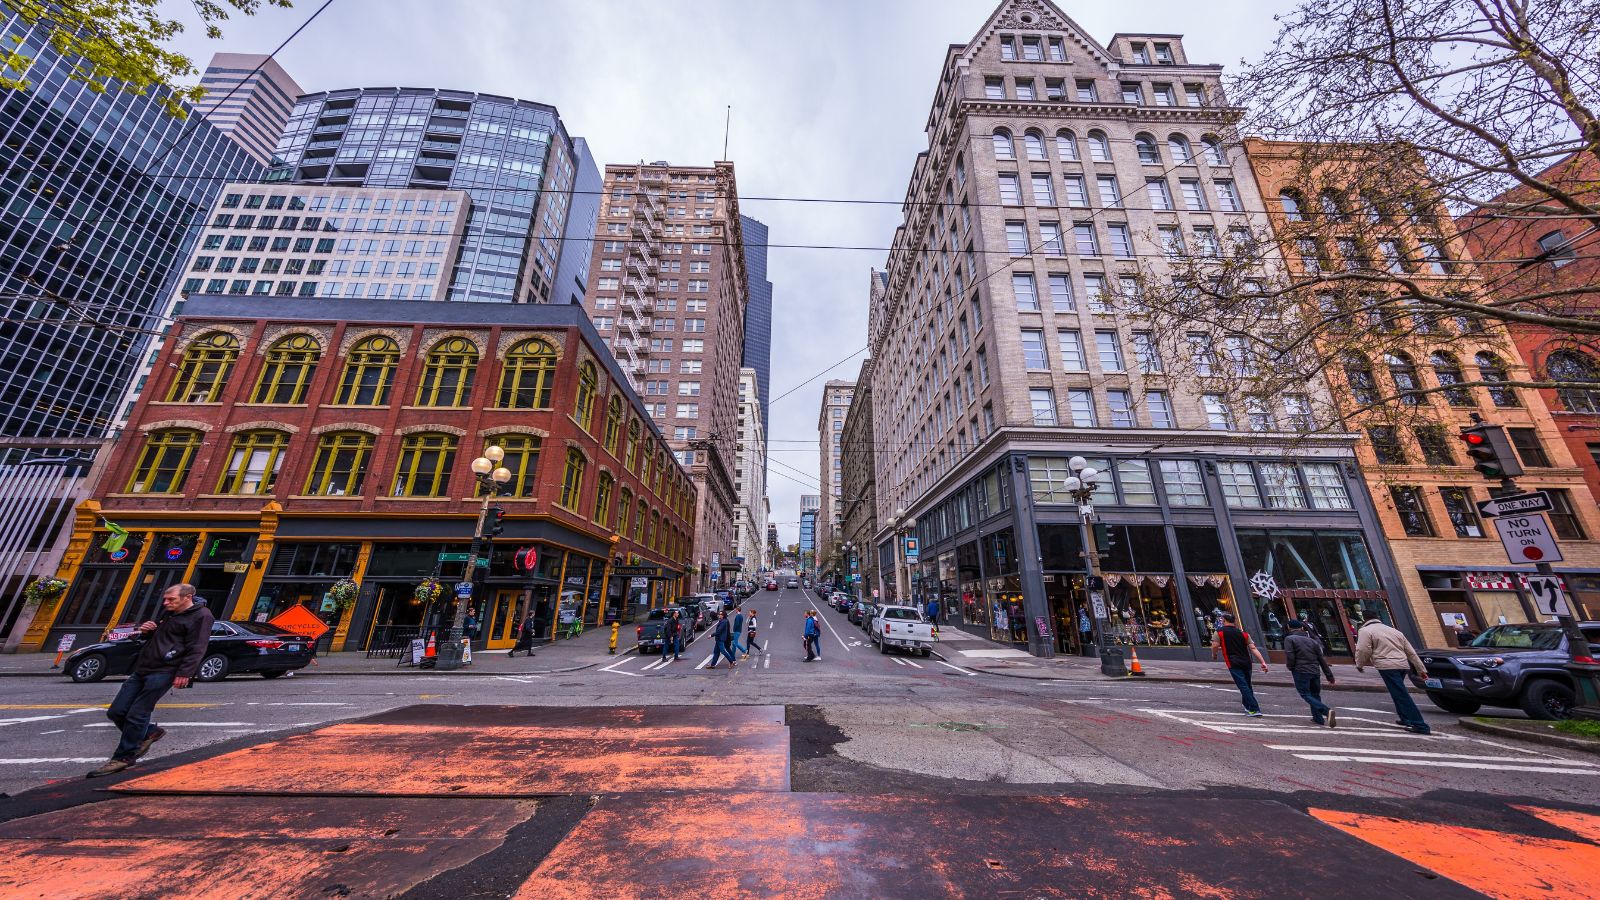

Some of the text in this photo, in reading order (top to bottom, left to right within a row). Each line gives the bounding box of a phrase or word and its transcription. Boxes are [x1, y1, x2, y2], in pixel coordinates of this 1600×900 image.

[1498, 498, 1540, 511] ONE WAY
[1508, 518, 1529, 528] NO
[1507, 528, 1541, 538] TURN
[1281, 589, 1383, 599] UTILIKILTS
